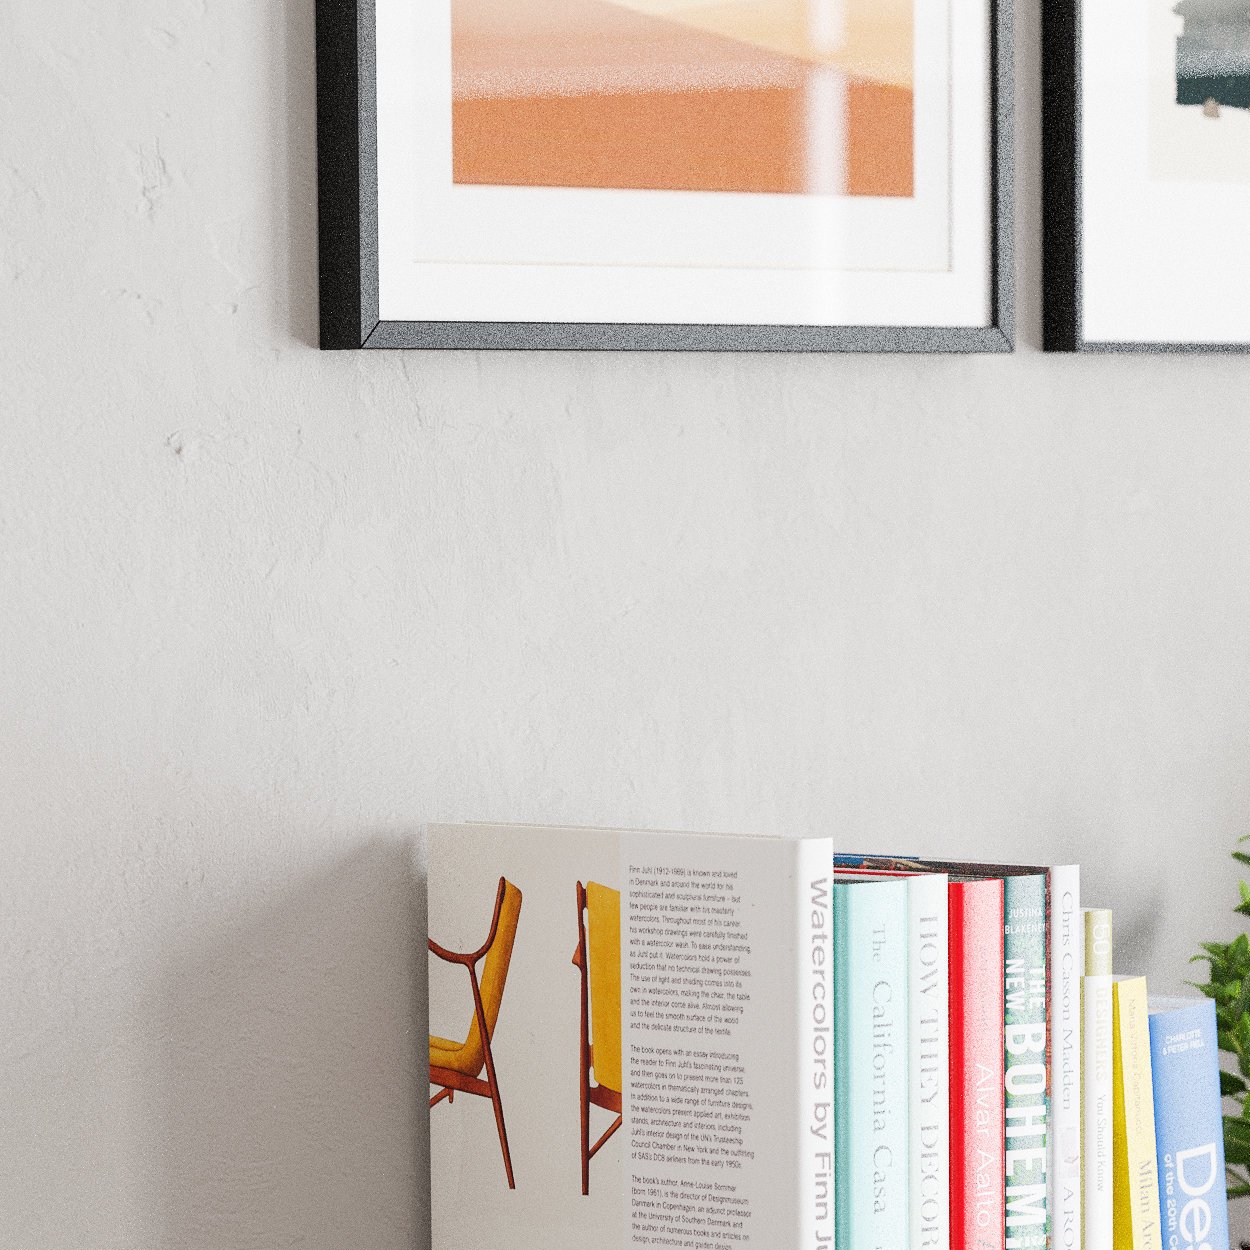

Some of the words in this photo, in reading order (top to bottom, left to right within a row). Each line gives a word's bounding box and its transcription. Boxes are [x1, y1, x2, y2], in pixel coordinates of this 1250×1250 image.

[872, 923, 887, 963] The
[1062, 890, 1074, 946] Chris
[1092, 924, 1110, 955] 50
[810, 877, 831, 1091] Watercolors
[918, 915, 939, 999] HOW
[1007, 958, 1026, 1011] NEW
[1029, 967, 1045, 1009] THE
[1062, 952, 1074, 1022] Casson
[872, 979, 895, 1134] California
[919, 1008, 940, 1106] THEY
[1095, 987, 1108, 1082] DESIGNERS
[976, 1062, 995, 1138] Alvar
[1062, 1028, 1075, 1111] Madden
[809, 1101, 832, 1141] by
[813, 1151, 833, 1222] Finn
[872, 1144, 894, 1216] Casa
[976, 1149, 996, 1228] Aalto
[1138, 1159, 1154, 1215] Milan
[1164, 1153, 1175, 1168] of
[1166, 1171, 1175, 1196] the
[1063, 1186, 1075, 1202] A
[1167, 1199, 1178, 1232] 20th
